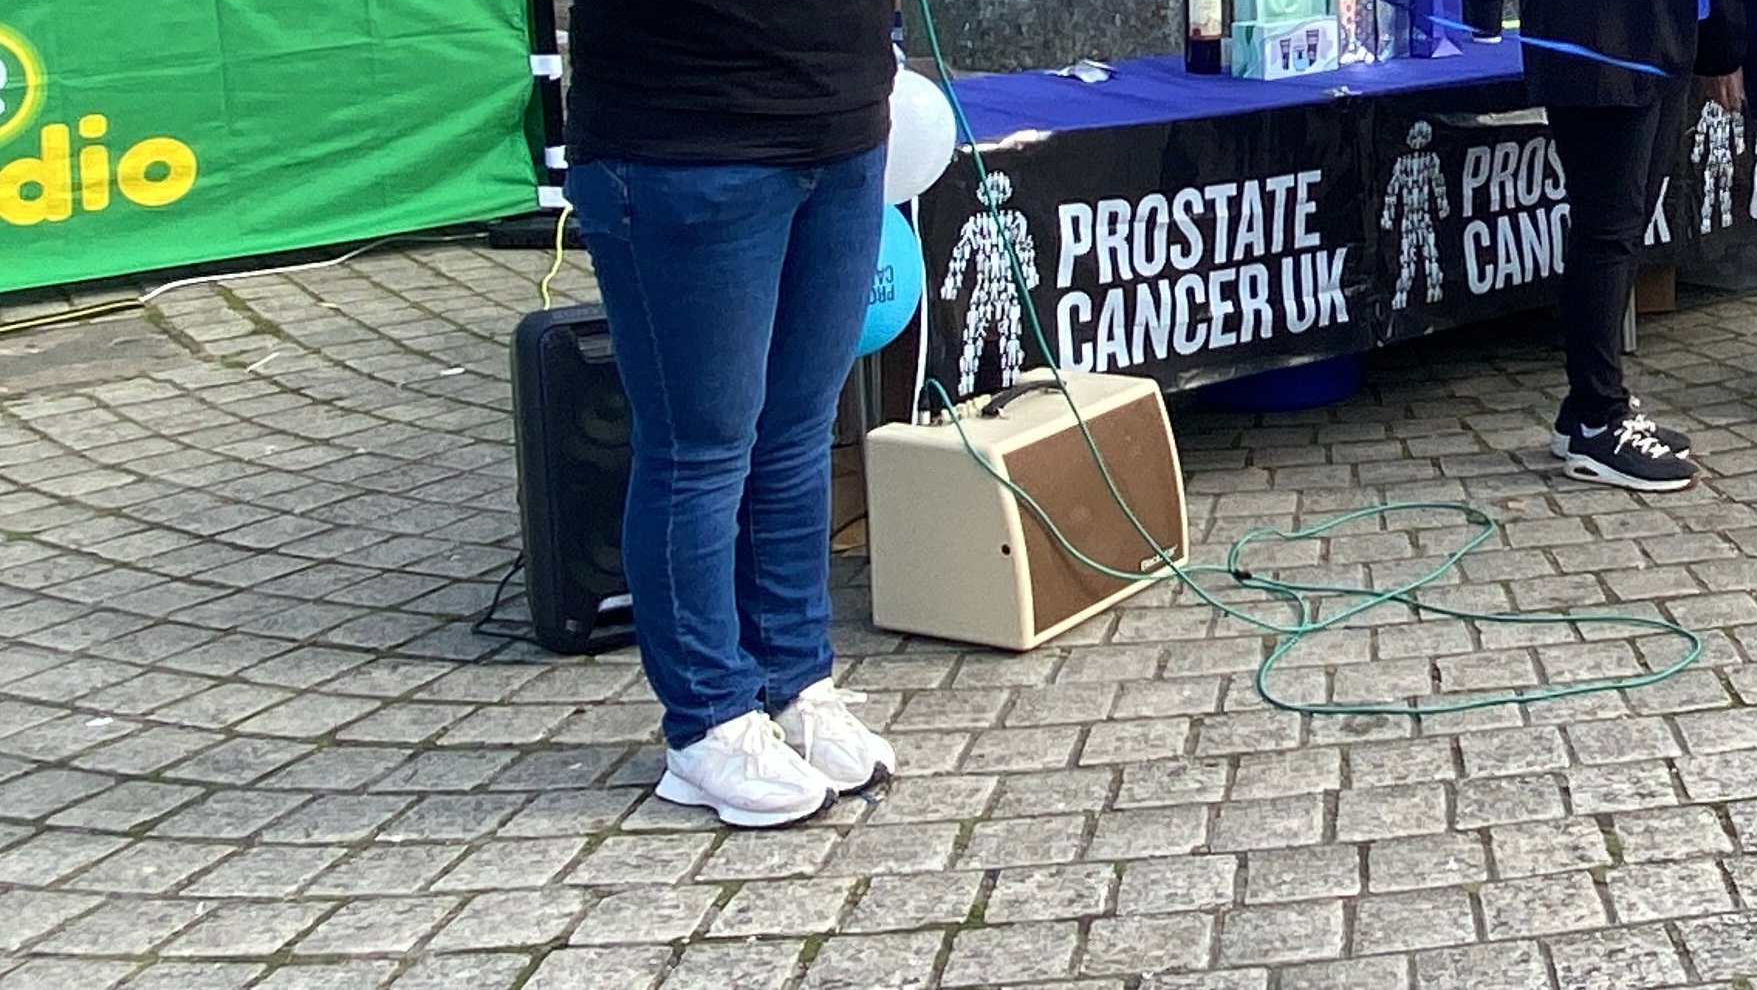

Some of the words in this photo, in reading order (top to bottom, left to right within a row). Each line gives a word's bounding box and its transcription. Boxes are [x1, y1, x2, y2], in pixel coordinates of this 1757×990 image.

[1056, 169, 1322, 289] PROSTATE
[1056, 262, 1274, 373] CANCER
[1281, 246, 1350, 334] UK
